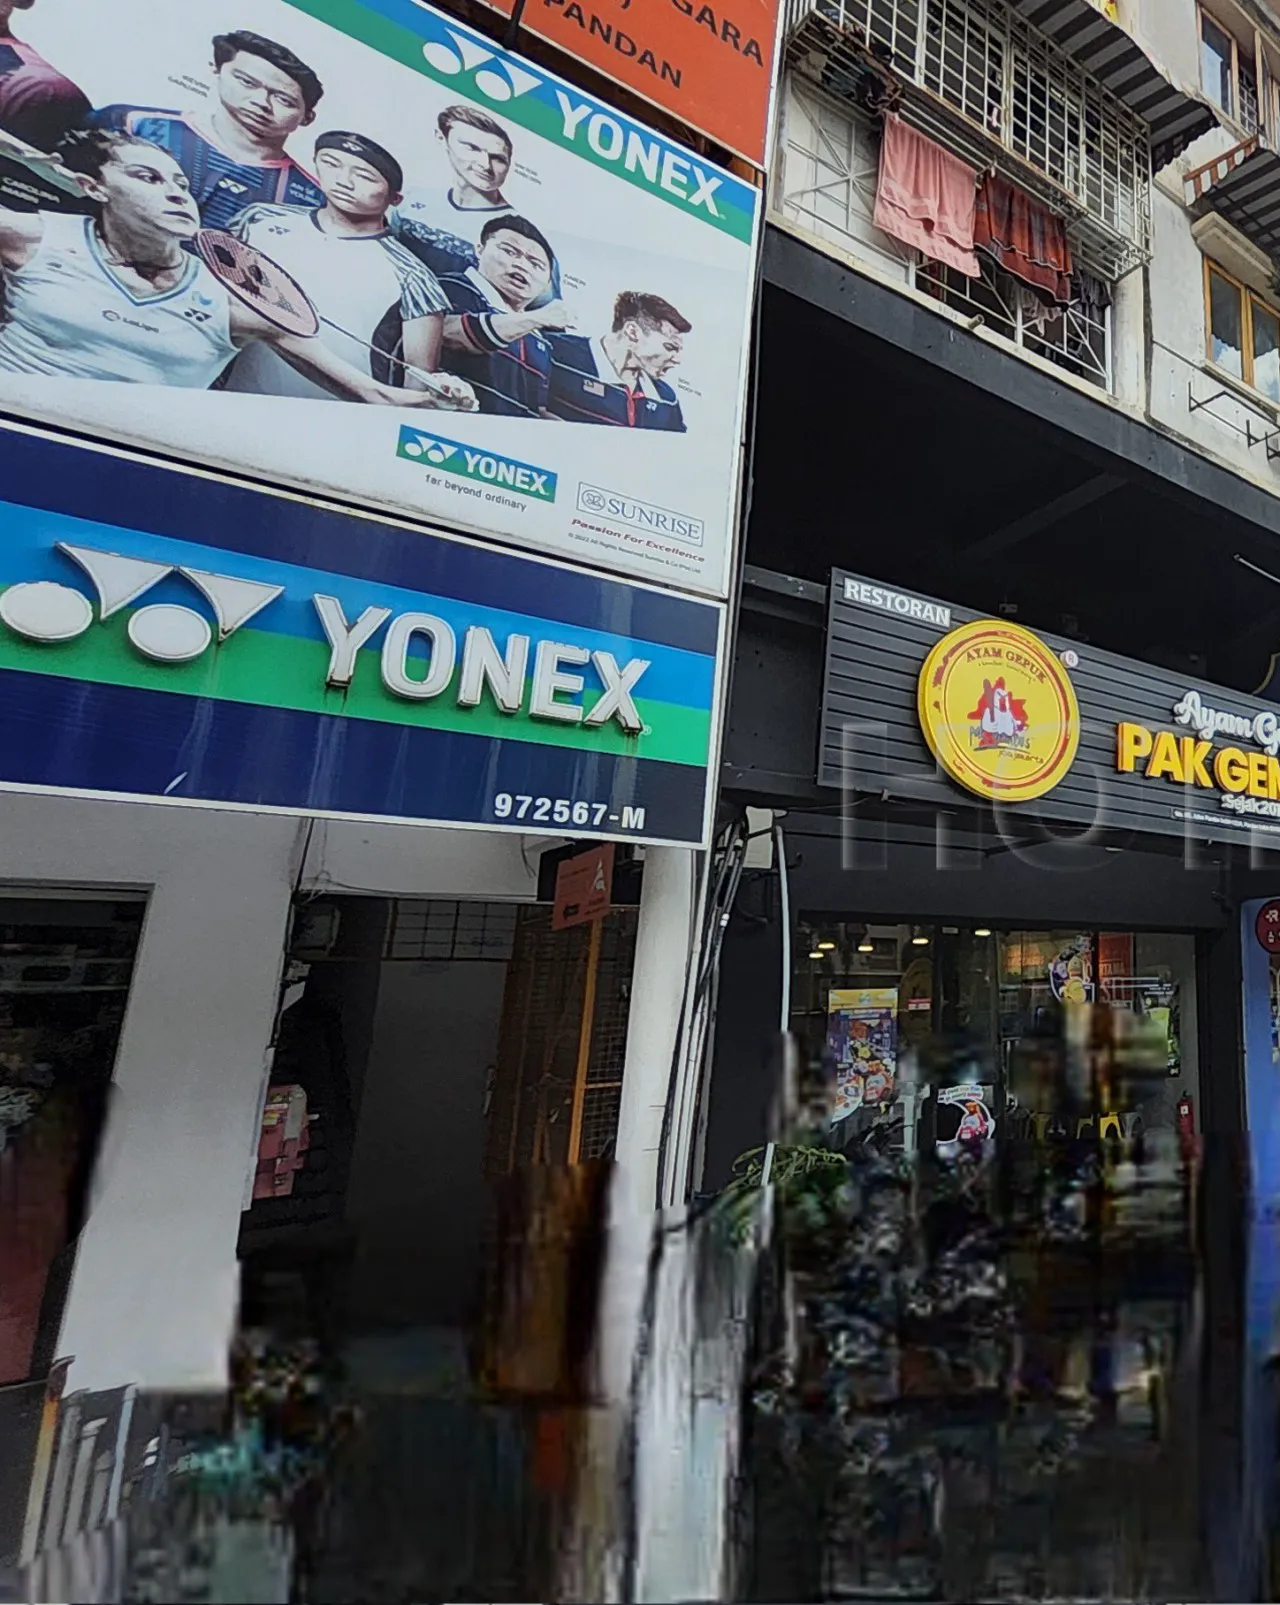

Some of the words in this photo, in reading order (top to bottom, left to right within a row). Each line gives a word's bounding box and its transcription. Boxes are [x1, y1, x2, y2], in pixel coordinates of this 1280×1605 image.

[543, 0, 682, 89] ANDAN
[555, 89, 723, 218] YONEX
[425, 473, 441, 486] far
[444, 479, 482, 499] beyond
[485, 491, 527, 512] ordinary
[463, 449, 549, 495] YONEX
[571, 518, 621, 538] Passion
[624, 534, 643, 544] For
[645, 540, 705, 562] Excellence
[607, 499, 700, 540] SUNRISE
[846, 579, 951, 627] RESTORAN
[313, 593, 651, 734] YONEX
[967, 647, 1002, 663] AYAM
[1006, 650, 1047, 684] GEPUK
[1173, 690, 1252, 739] Ayam
[1116, 721, 1214, 788] PAK
[494, 793, 646, 830] 972567-M
